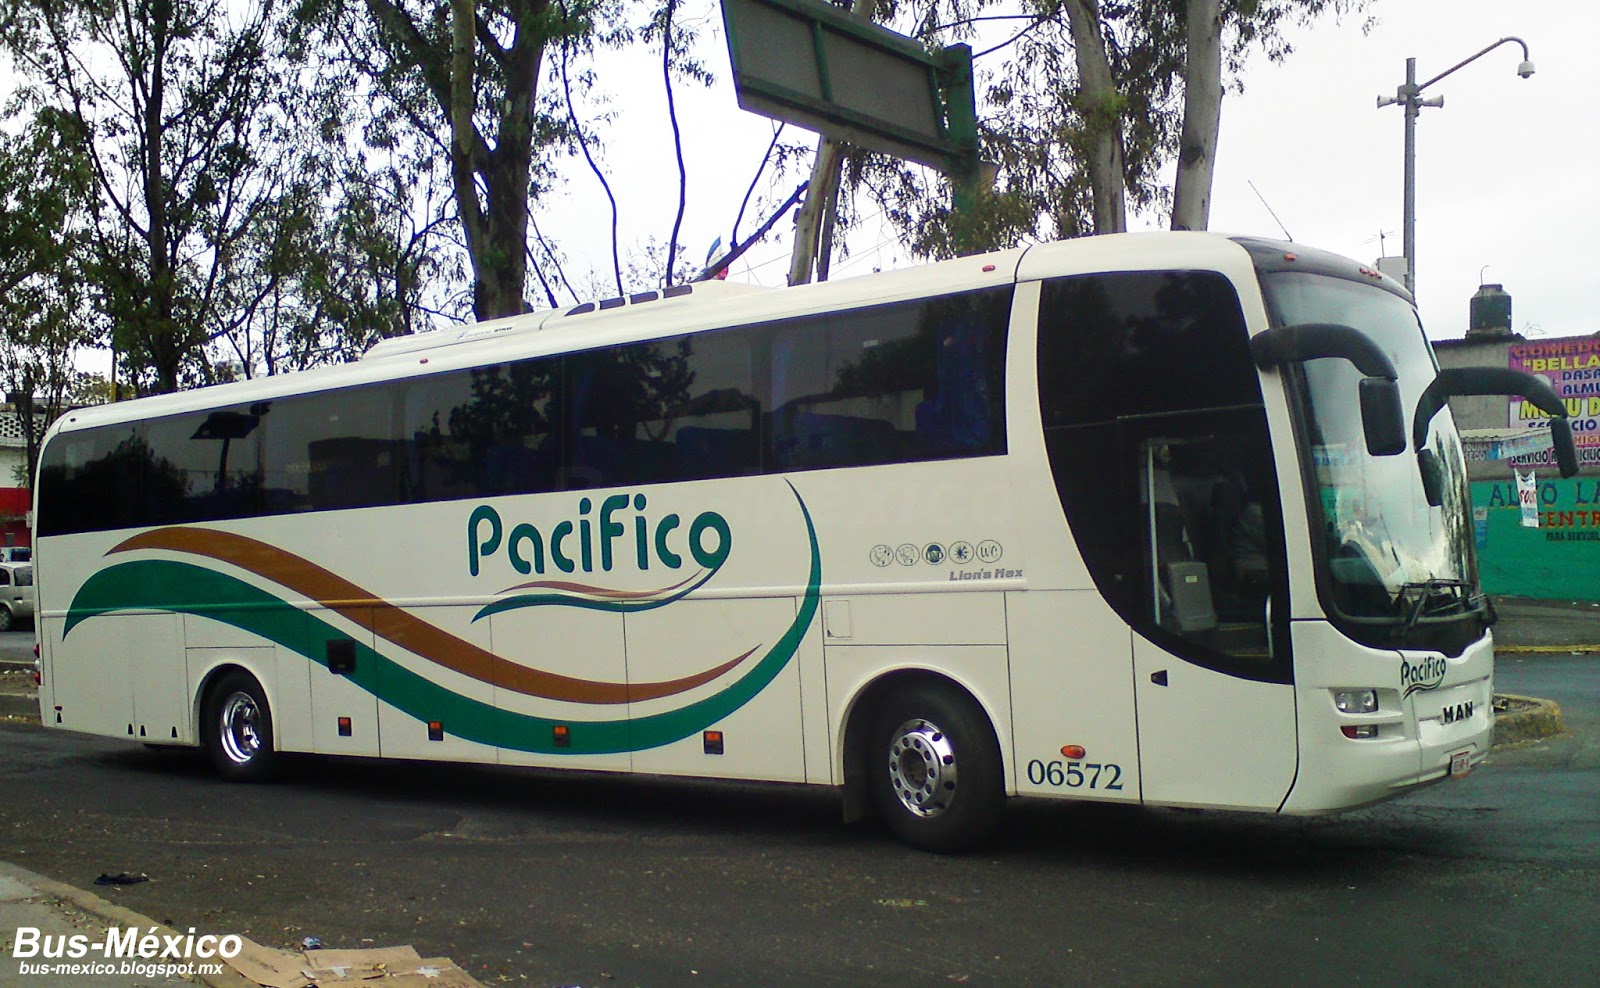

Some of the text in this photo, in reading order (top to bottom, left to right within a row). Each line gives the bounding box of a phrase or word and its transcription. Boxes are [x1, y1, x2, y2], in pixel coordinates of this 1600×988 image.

[1519, 397, 1582, 420] MU
[1489, 483, 1558, 508] ALO
[467, 493, 732, 577] Pacifico
[949, 568, 992, 581] Lion's
[1401, 656, 1446, 686] Pacifico
[1443, 701, 1473, 723] MAN
[1027, 759, 1124, 790] 06572
